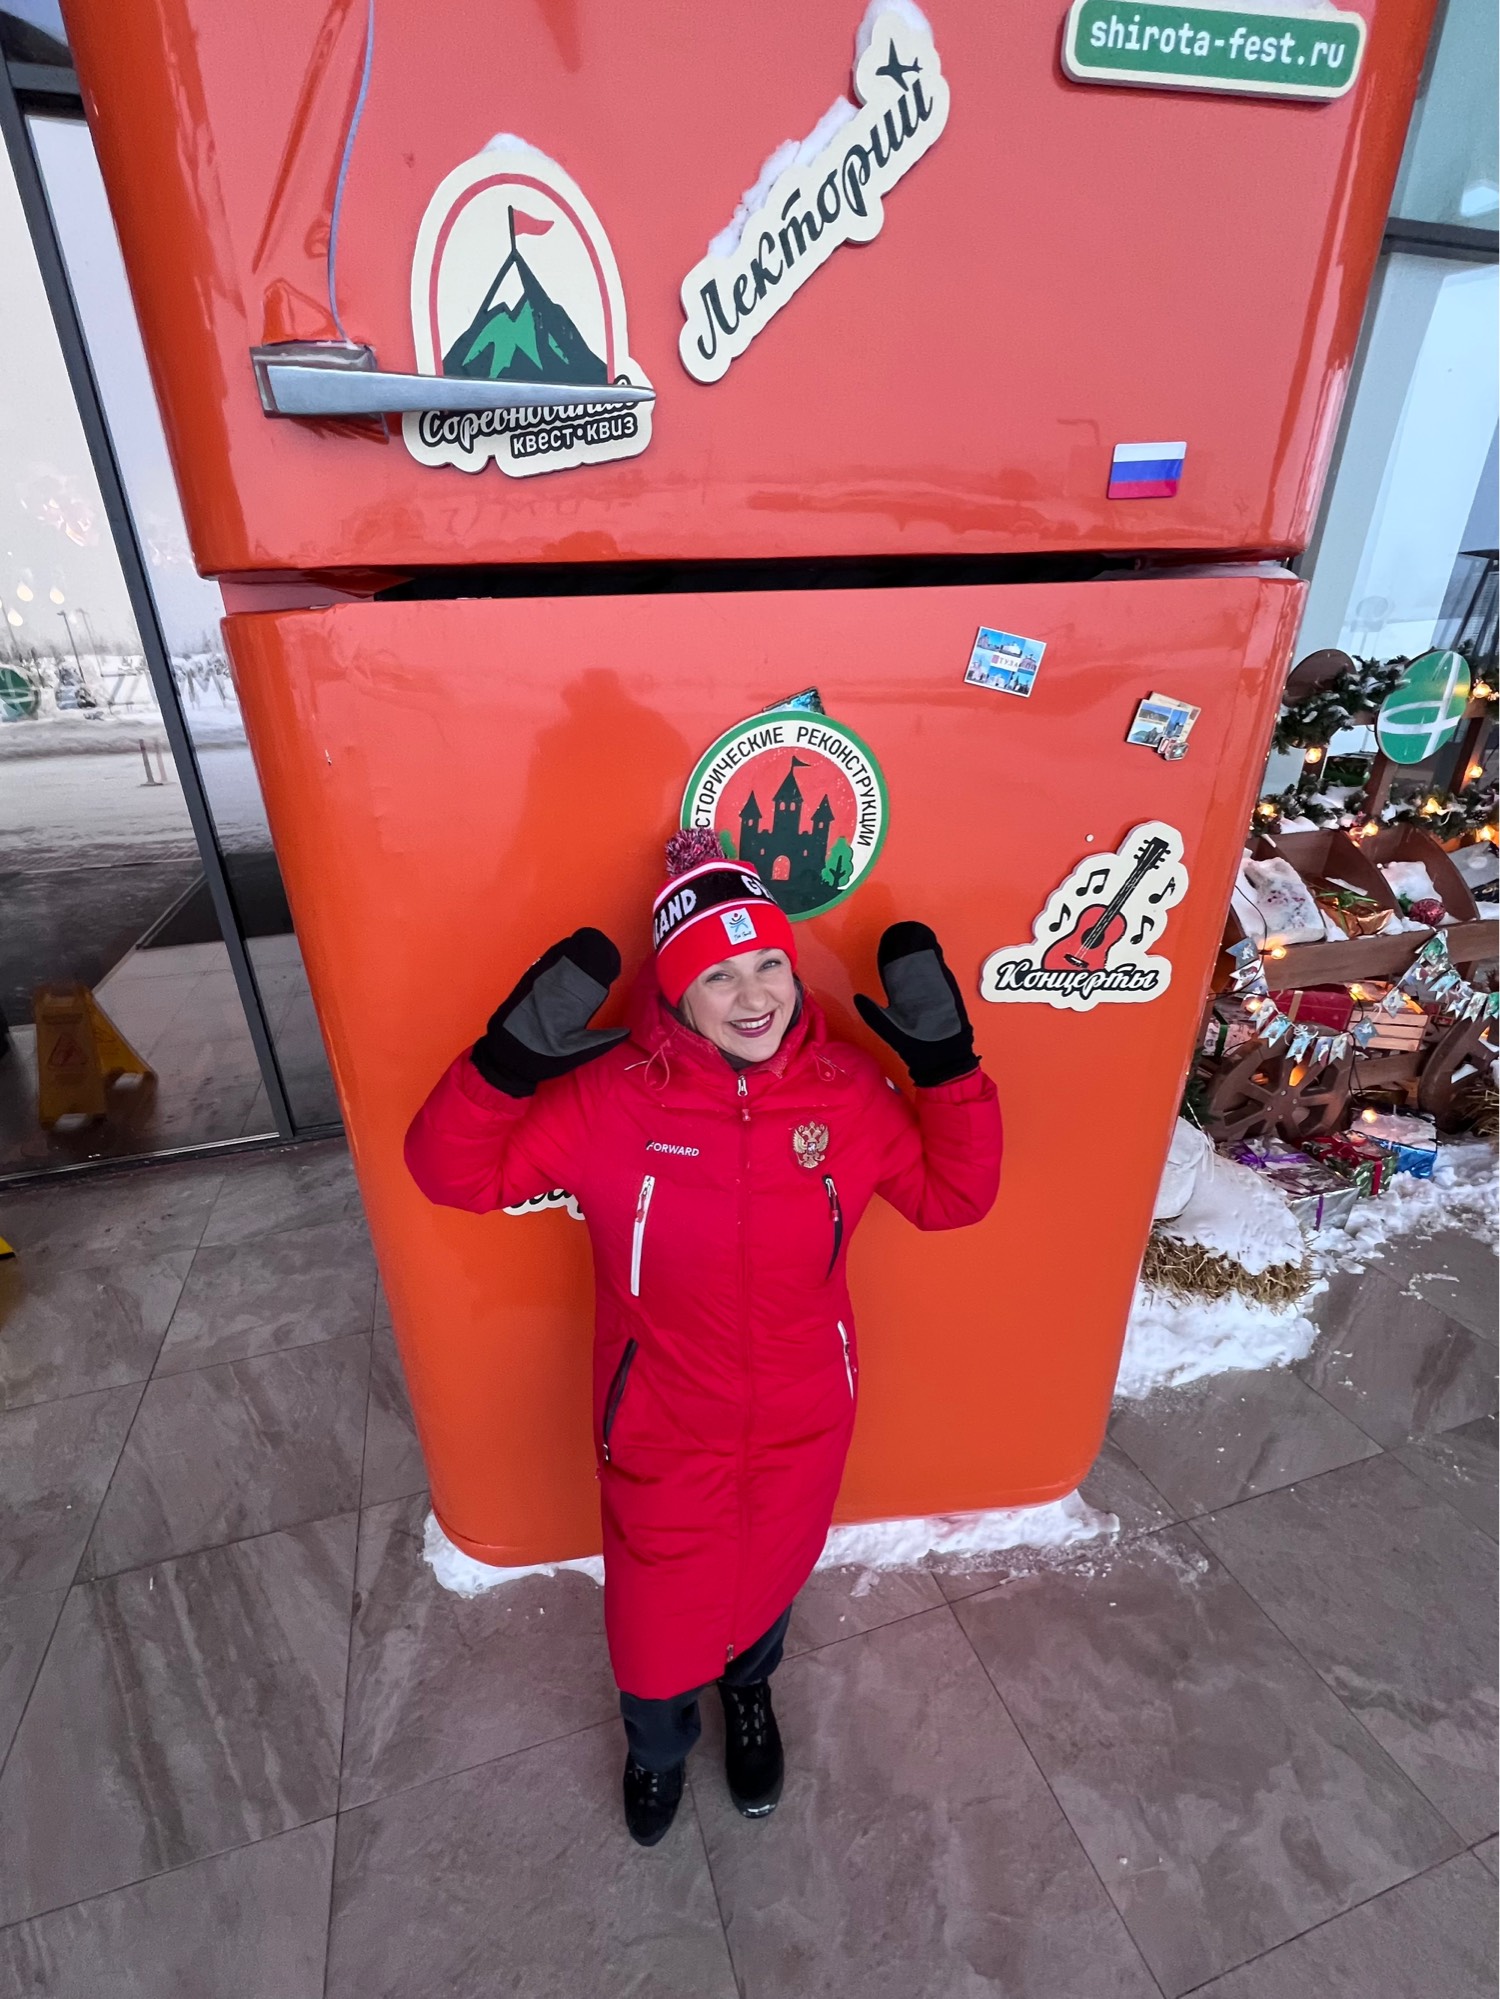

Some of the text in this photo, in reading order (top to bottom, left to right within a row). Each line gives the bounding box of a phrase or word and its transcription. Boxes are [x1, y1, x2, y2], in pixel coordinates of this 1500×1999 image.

[1090, 15, 1345, 68] shirota-fest.ru
[421, 378, 637, 452] Соревнова
[694, 726, 877, 847] СТОРИЧЕСКИЕ РЕКОНСТРУКЦИИ
[652, 888, 698, 950] LAND
[996, 960, 1159, 1000] Концерты
[646, 1140, 700, 1157] FORWARD
